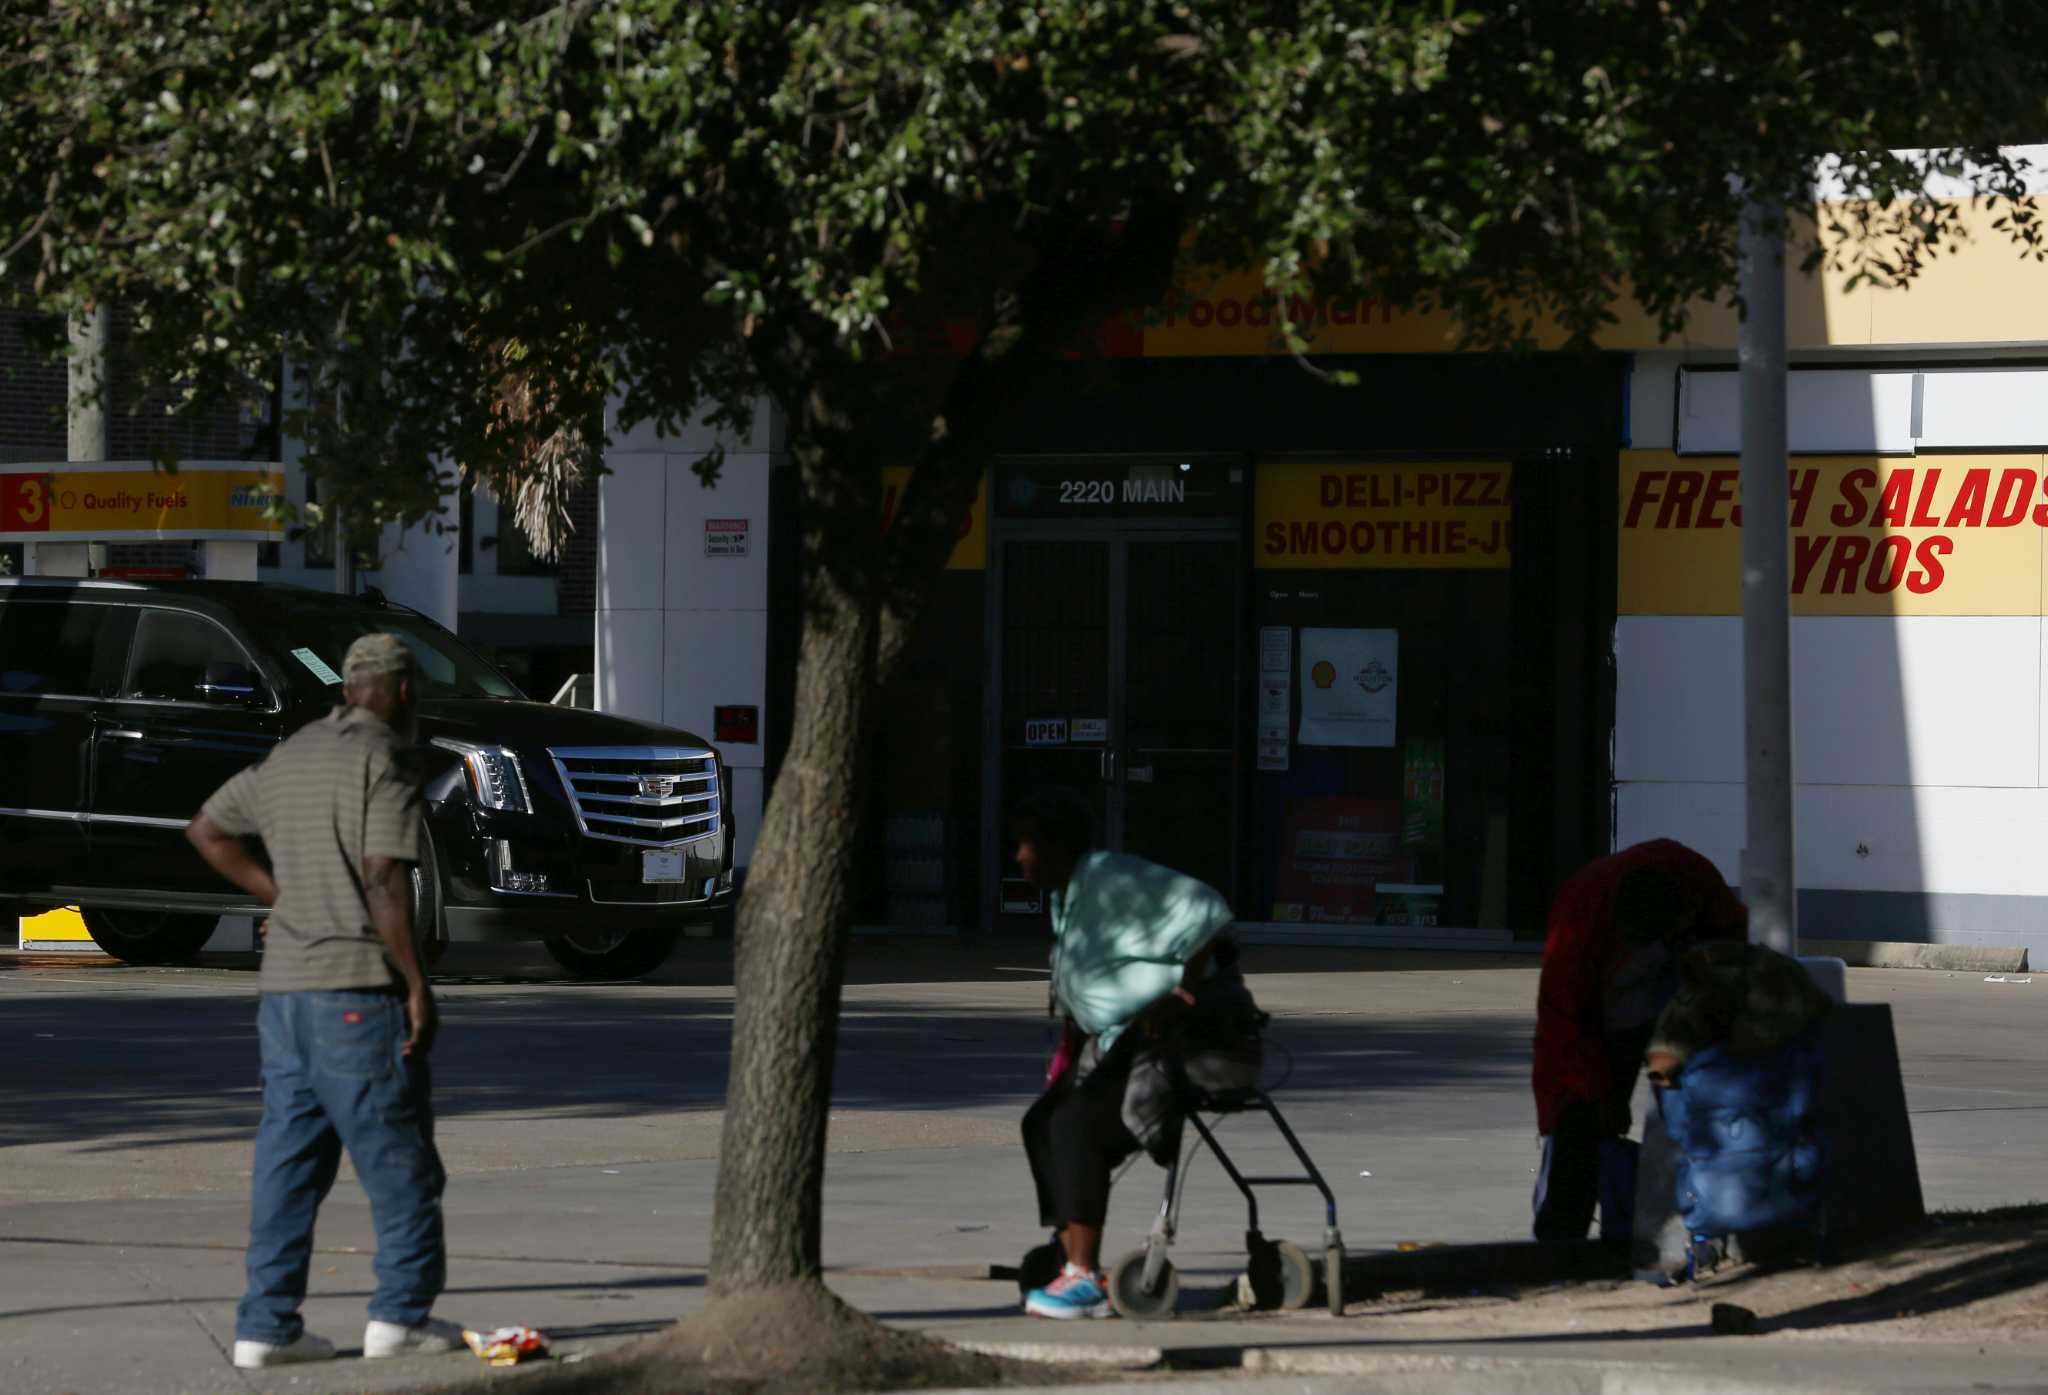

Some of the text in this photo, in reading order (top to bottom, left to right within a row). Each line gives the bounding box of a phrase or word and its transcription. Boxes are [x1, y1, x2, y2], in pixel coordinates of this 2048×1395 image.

[17, 479, 44, 524] 3
[83, 489, 188, 512] Quality Fuels
[1059, 479, 1185, 503] 2220 MAIN
[1623, 469, 1819, 528] FREH
[1792, 535, 1953, 594] YROS
[1026, 722, 1065, 740] OPEN
